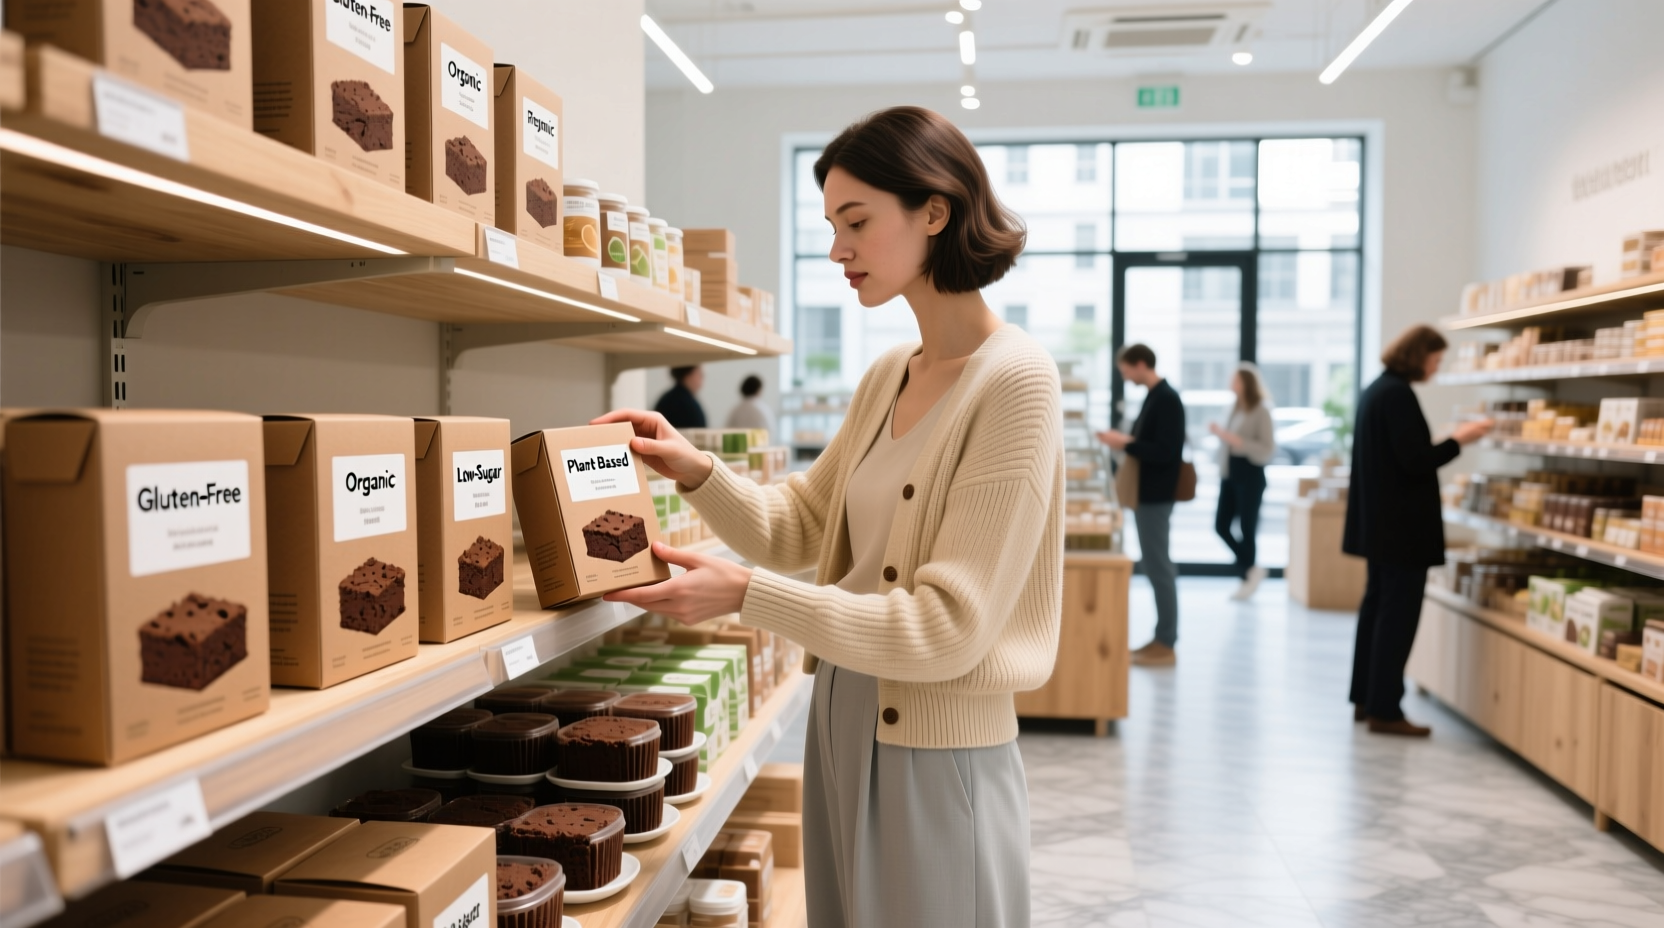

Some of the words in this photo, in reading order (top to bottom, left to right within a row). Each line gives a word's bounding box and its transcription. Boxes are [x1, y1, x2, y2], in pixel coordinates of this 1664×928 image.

[457, 464, 502, 483] Low-Sugar
[567, 458, 596, 473] Plant
[597, 452, 629, 469] Based
[346, 470, 395, 496] Organic
[137, 483, 241, 512] Gluten-Free
